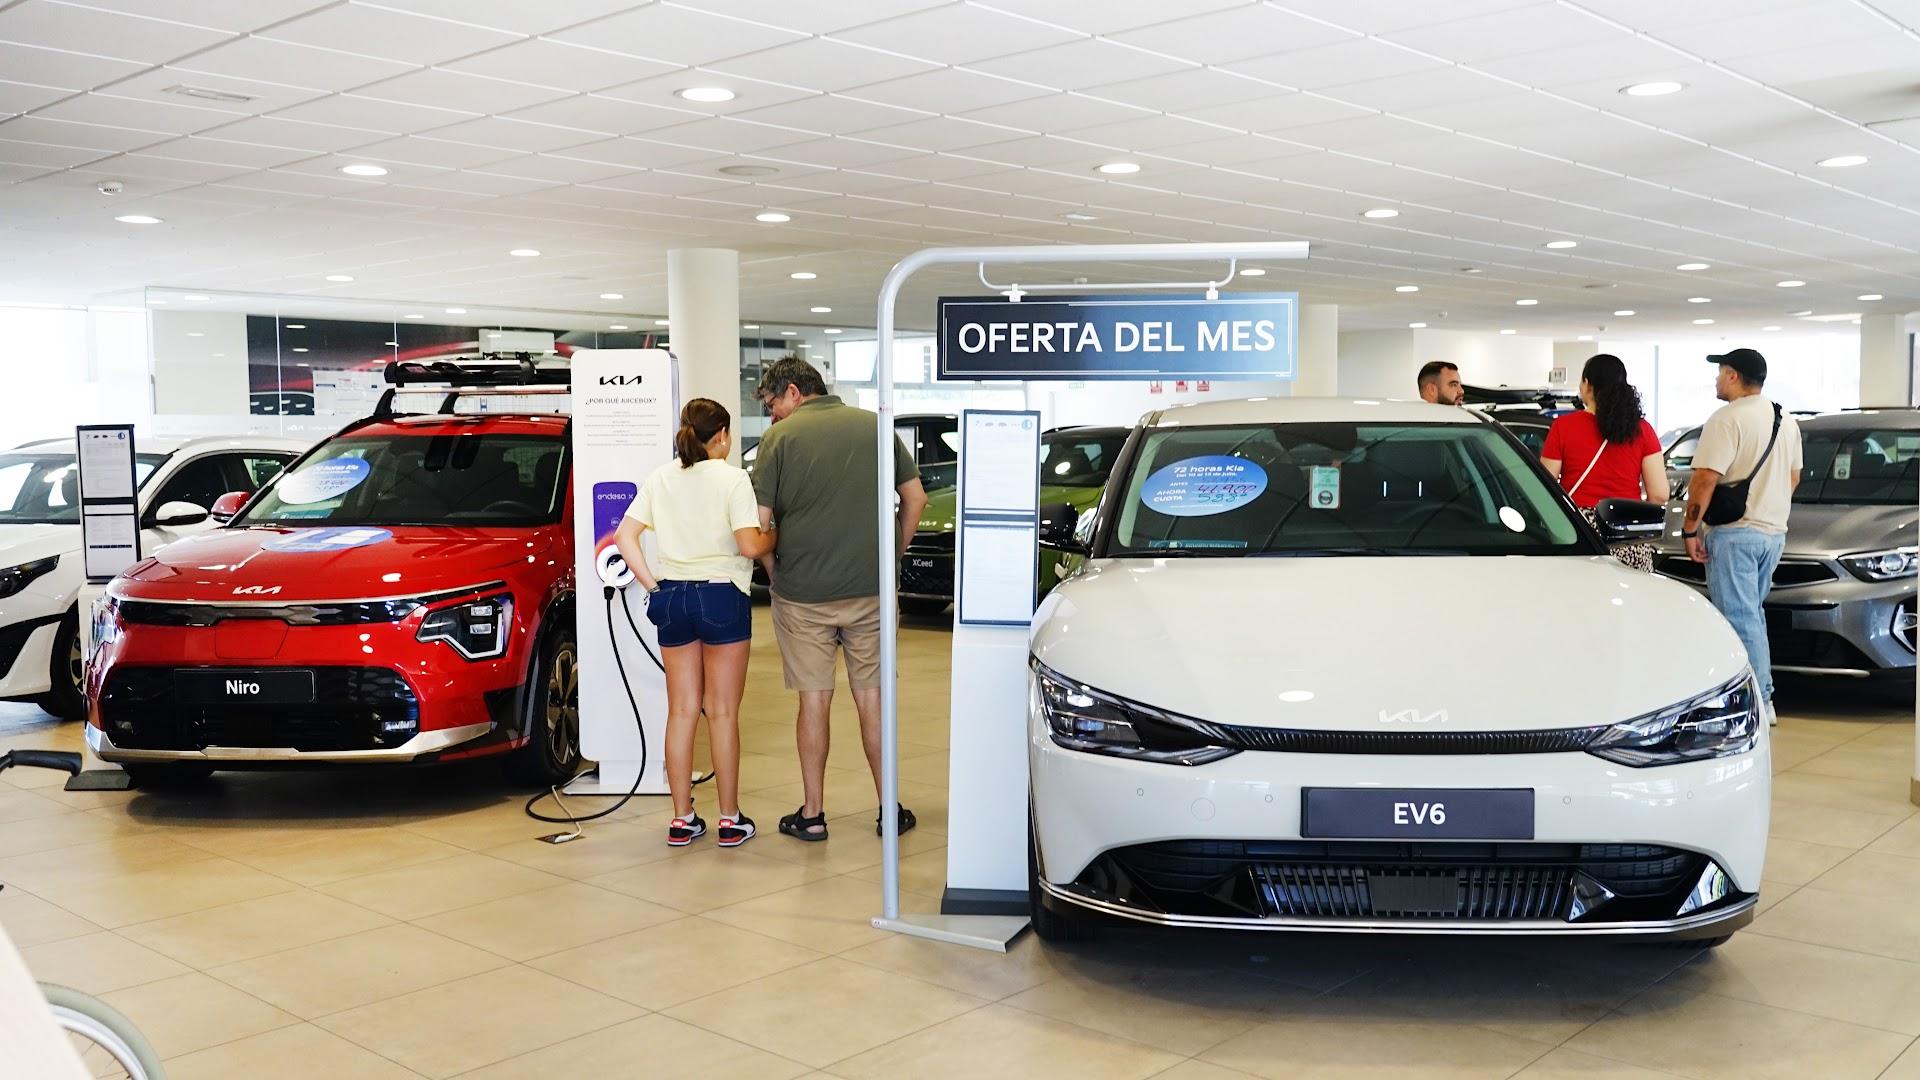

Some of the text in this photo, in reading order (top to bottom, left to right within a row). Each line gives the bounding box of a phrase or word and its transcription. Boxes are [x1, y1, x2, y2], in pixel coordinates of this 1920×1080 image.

[957, 320, 1276, 354] OFERTA DEL MES
[599, 375, 642, 386] KIA
[585, 397, 604, 405] ¿POR
[605, 396, 619, 404] QUÉ
[597, 492, 627, 500] endesa
[1156, 488, 1186, 496] AHORA
[912, 559, 933, 568] XCeed
[232, 585, 282, 595] KIA
[226, 680, 260, 694] Niro
[1378, 708, 1449, 722] KIA
[1394, 802, 1446, 825] EV6
